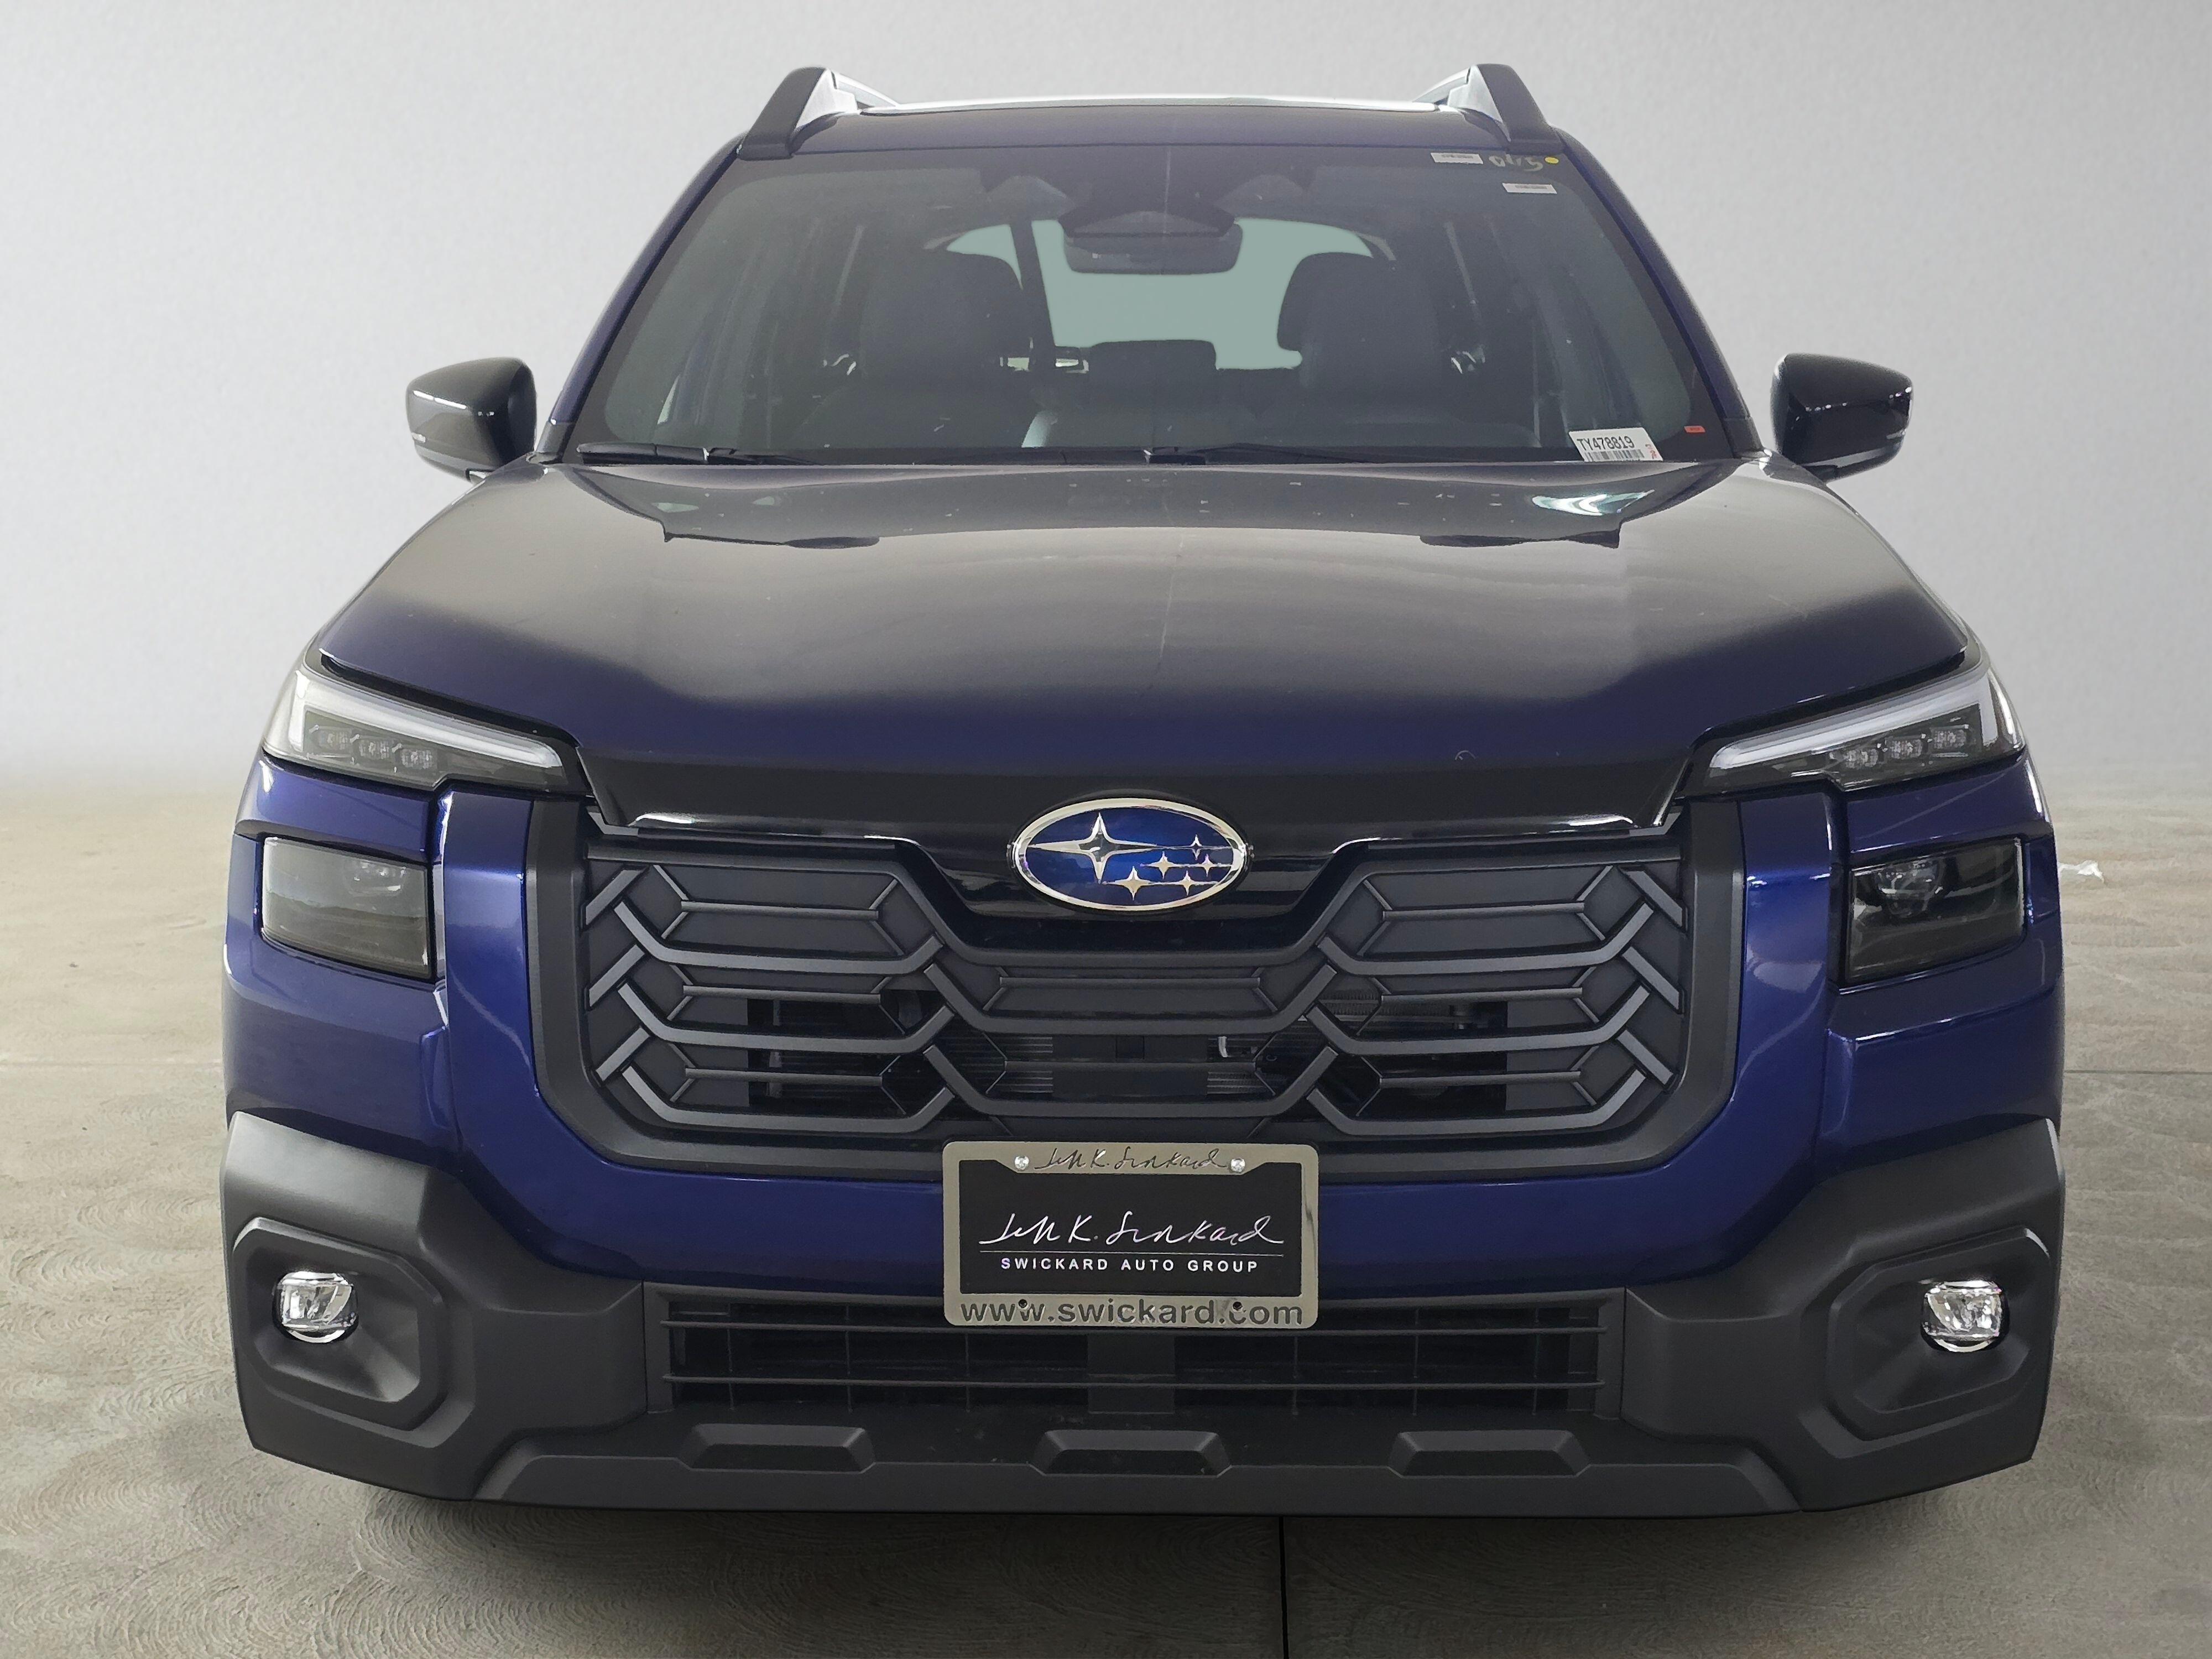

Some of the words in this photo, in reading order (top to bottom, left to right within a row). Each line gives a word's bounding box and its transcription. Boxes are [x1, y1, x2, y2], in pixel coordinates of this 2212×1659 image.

[1577, 436, 1635, 451] TY478819
[1001, 1258, 1108, 1270] SWICKARD
[1120, 1259, 1174, 1271] AUTO
[1187, 1259, 1258, 1272] GROUP
[960, 1298, 1303, 1325] www.swickard.com
